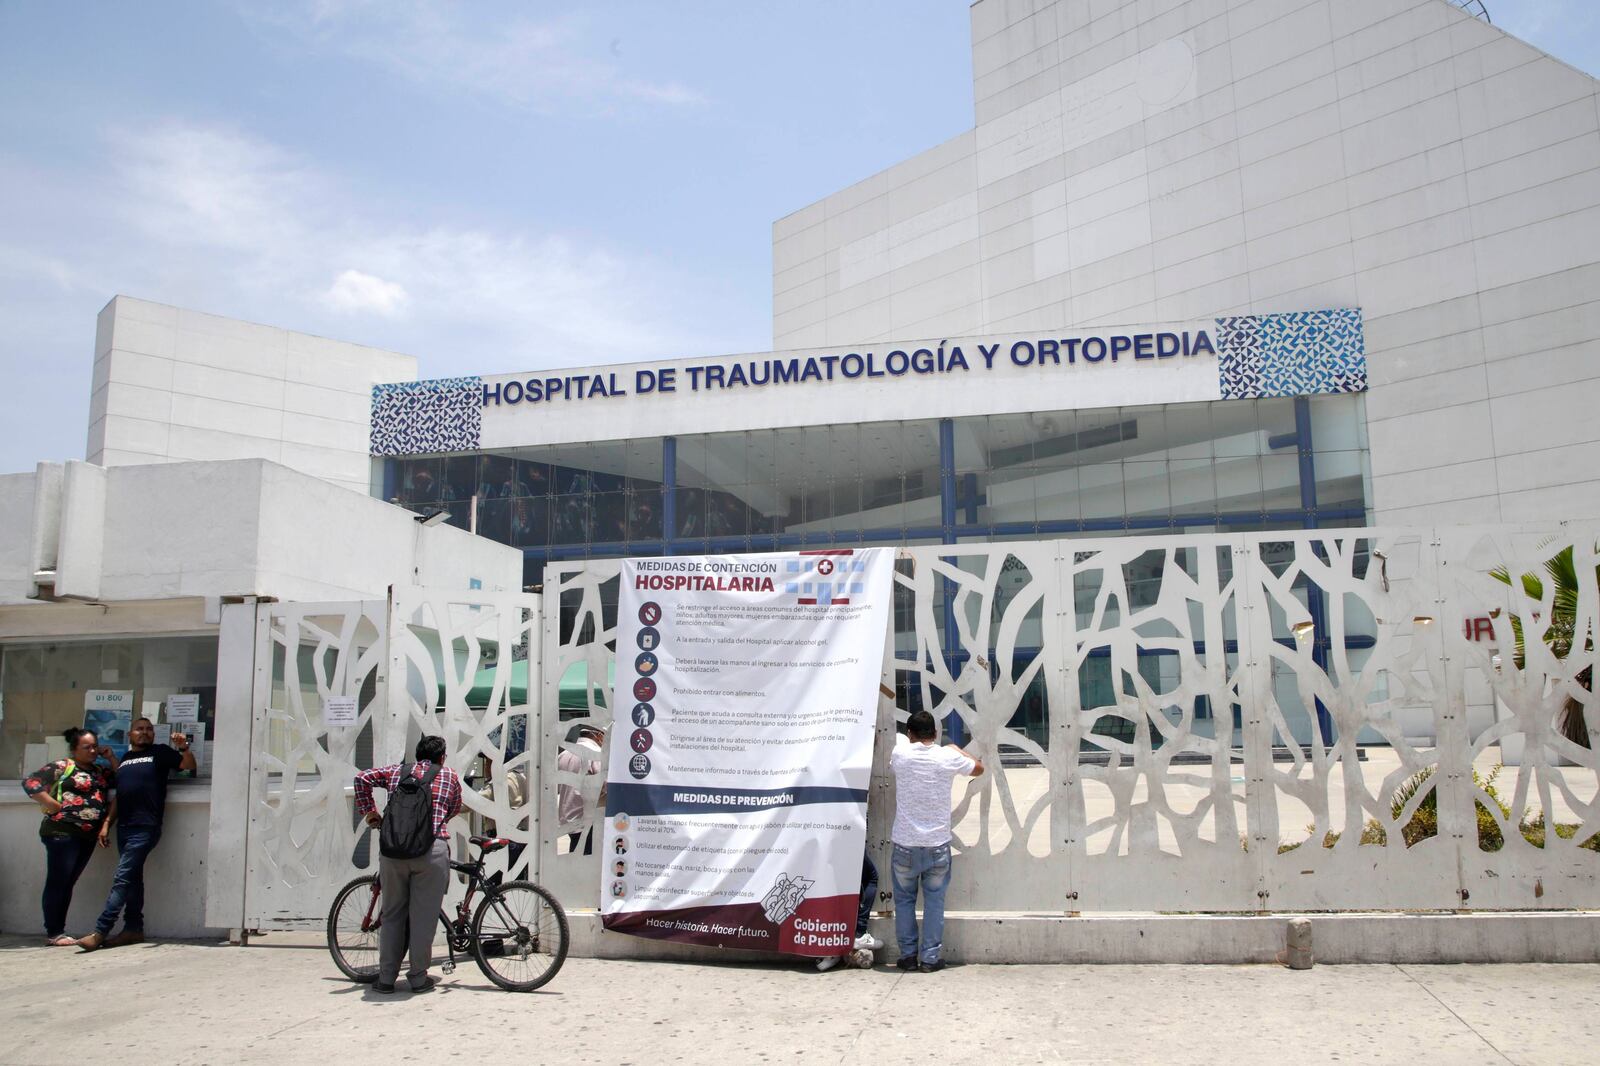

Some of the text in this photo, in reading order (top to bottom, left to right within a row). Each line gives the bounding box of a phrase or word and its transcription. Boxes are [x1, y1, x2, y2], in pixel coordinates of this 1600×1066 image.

[483, 330, 1216, 407] HOSPITAL DE TRAUMATOLOGÍA Y ORTOPEDIA
[636, 561, 776, 573] MEDIDAS DE CONTENCIÓN
[635, 574, 774, 592] HOSPITALARIA
[686, 604, 711, 613] restringe
[804, 606, 829, 614] hospital
[773, 638, 793, 646] aplicar
[675, 657, 697, 665] Deberá
[758, 660, 784, 668] ingresar
[673, 687, 701, 695] Prohibido
[107, 694, 123, 702] 800
[672, 708, 697, 716] Paciente
[787, 712, 797, 720] y/o
[834, 708, 863, 716] permitirá
[718, 718, 760, 727] acompañante
[670, 742, 709, 750] instalaciones
[734, 737, 761, 745] atención
[704, 766, 736, 774] informado
[742, 768, 760, 776] través
[762, 768, 769, 776] de
[673, 792, 793, 806] MEDIDAS DE PREVENCIÓN
[688, 820, 738, 829] frecuentemente
[764, 822, 781, 831] jabón
[803, 821, 812, 831] gel
[826, 823, 841, 831] base
[842, 823, 851, 831] de
[701, 846, 726, 855] etiqueta
[744, 847, 764, 856] pliegue
[703, 865, 717, 873] boca
[646, 918, 770, 938] Hacer historia. Hacer futuro.
[793, 918, 847, 932] Gobierno
[793, 932, 850, 947] de Puebla
